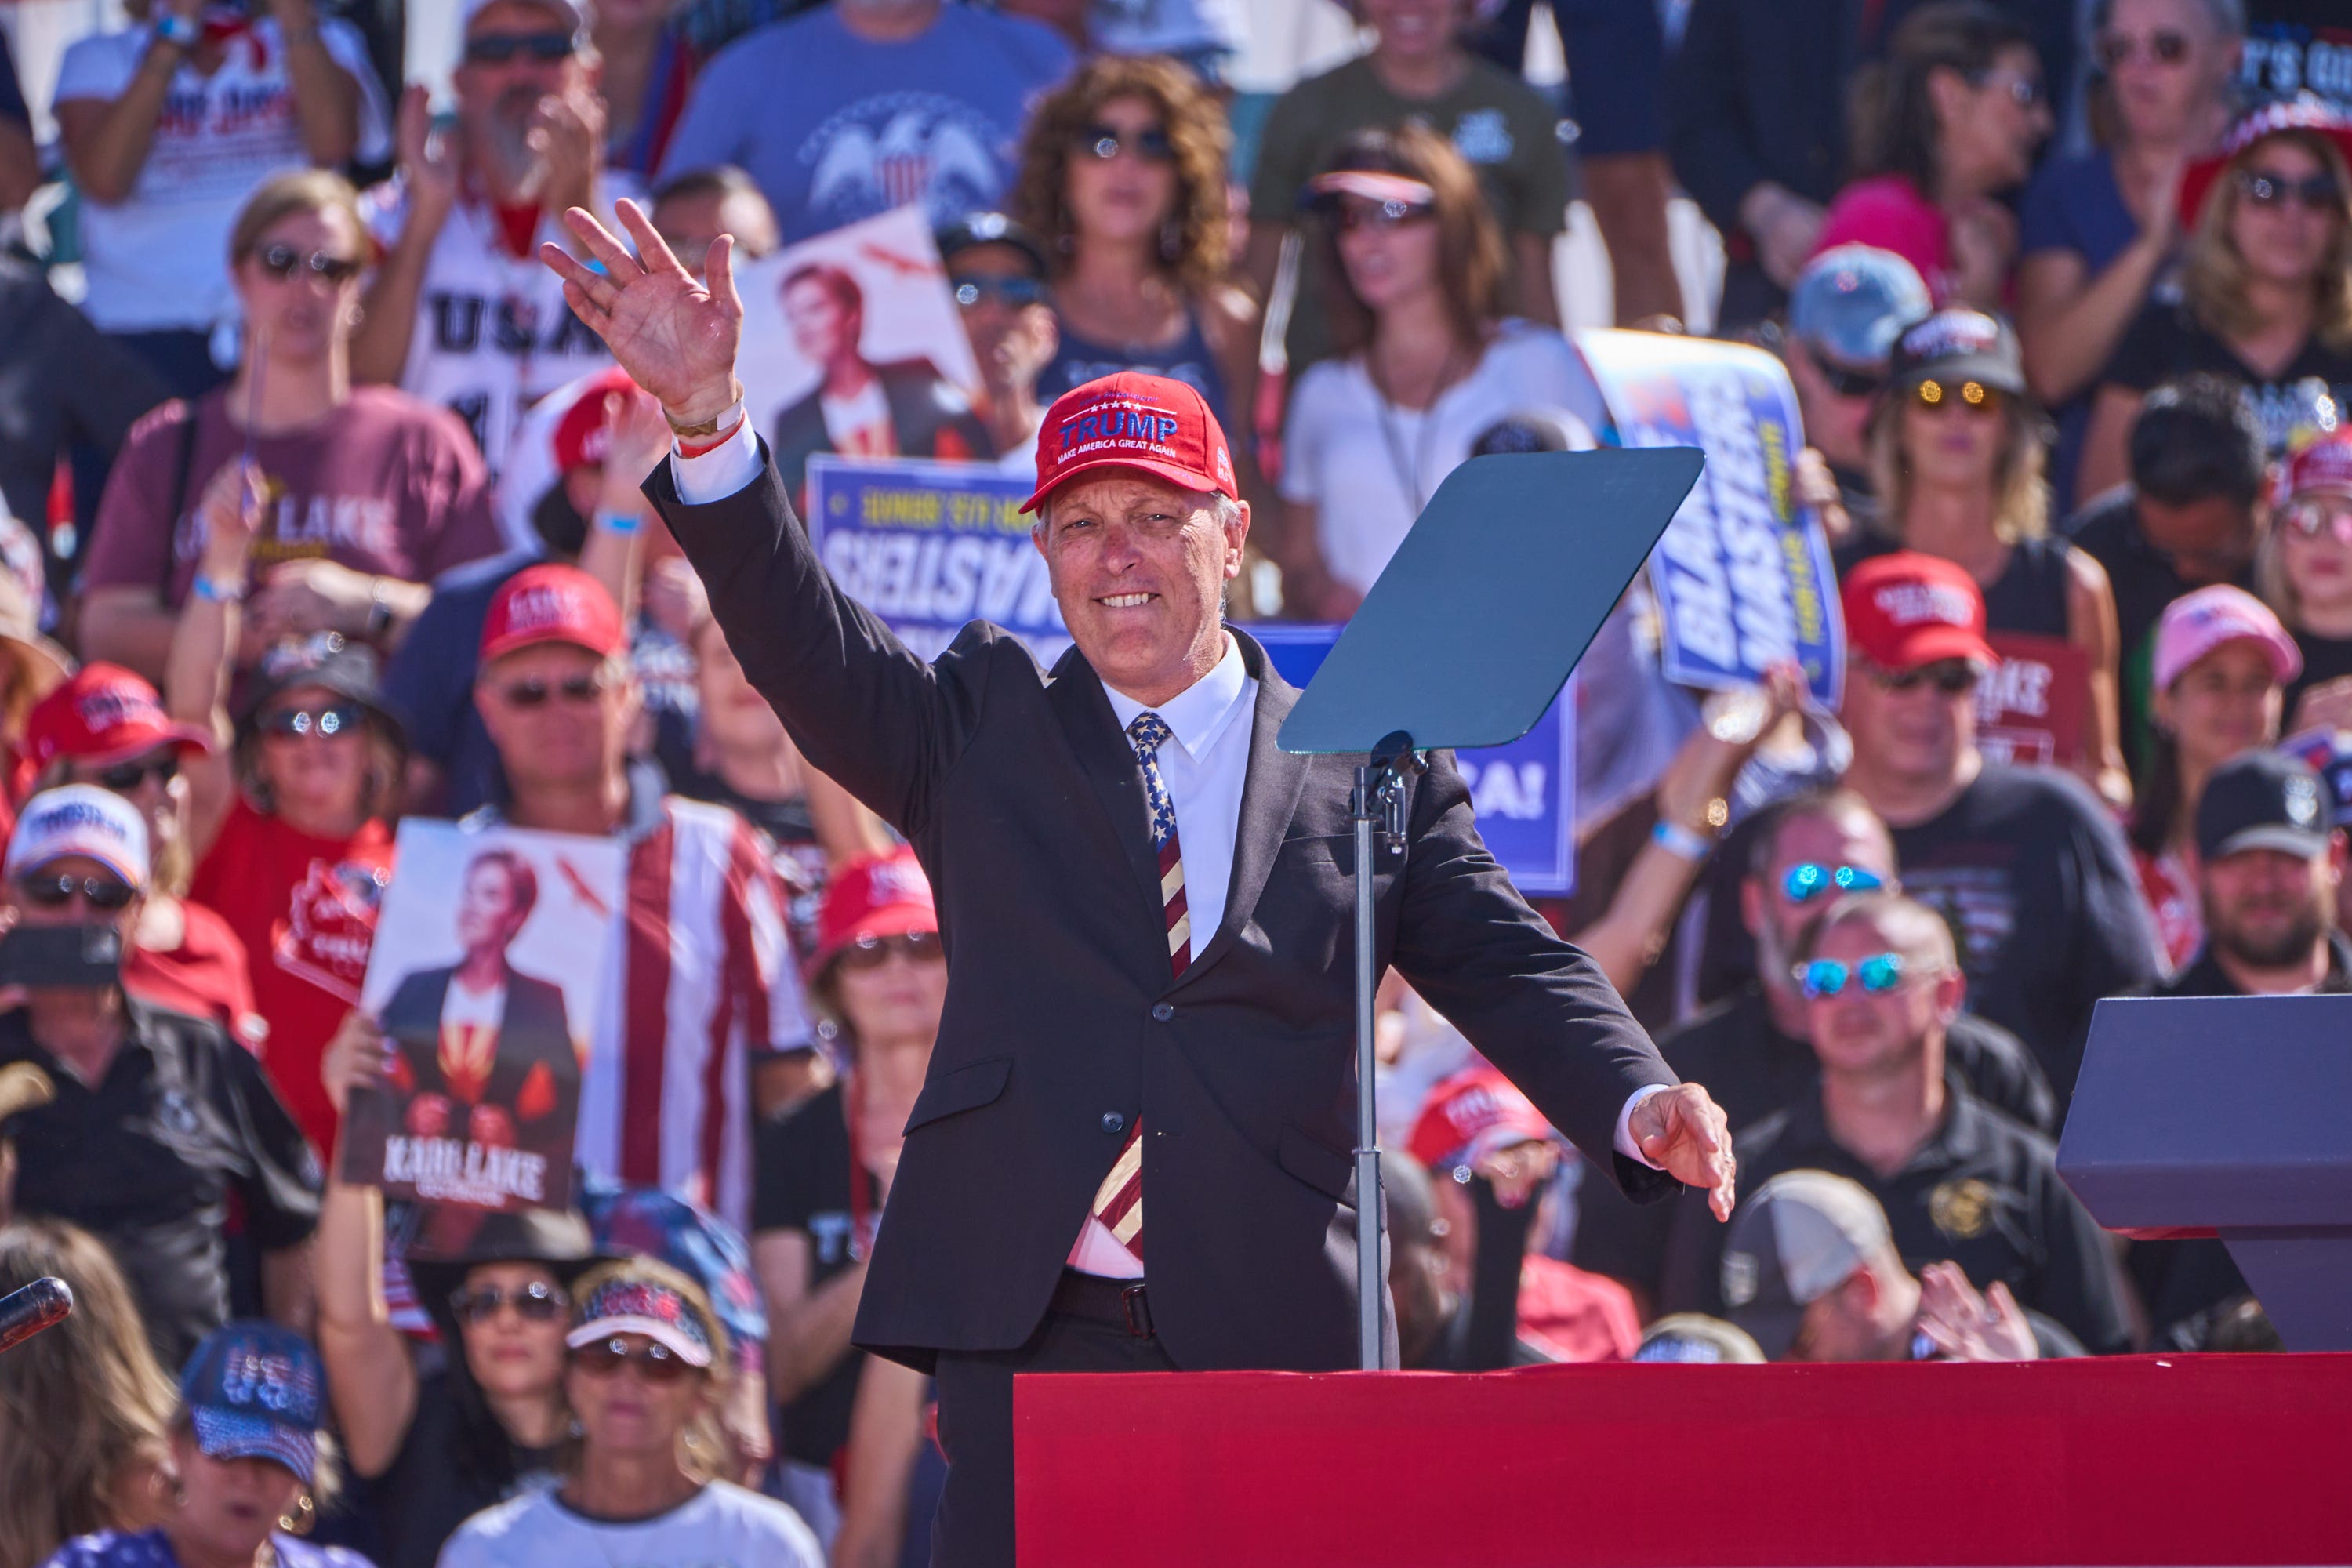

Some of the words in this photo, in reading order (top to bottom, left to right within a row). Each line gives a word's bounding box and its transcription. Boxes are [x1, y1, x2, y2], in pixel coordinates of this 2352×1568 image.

[1059, 411, 1178, 449] TRUMP
[1058, 448, 1076, 465] MAKE
[1077, 438, 1116, 454] AMERICA
[1118, 439, 1147, 450] GREAT
[1149, 442, 1176, 458] AGAIN
